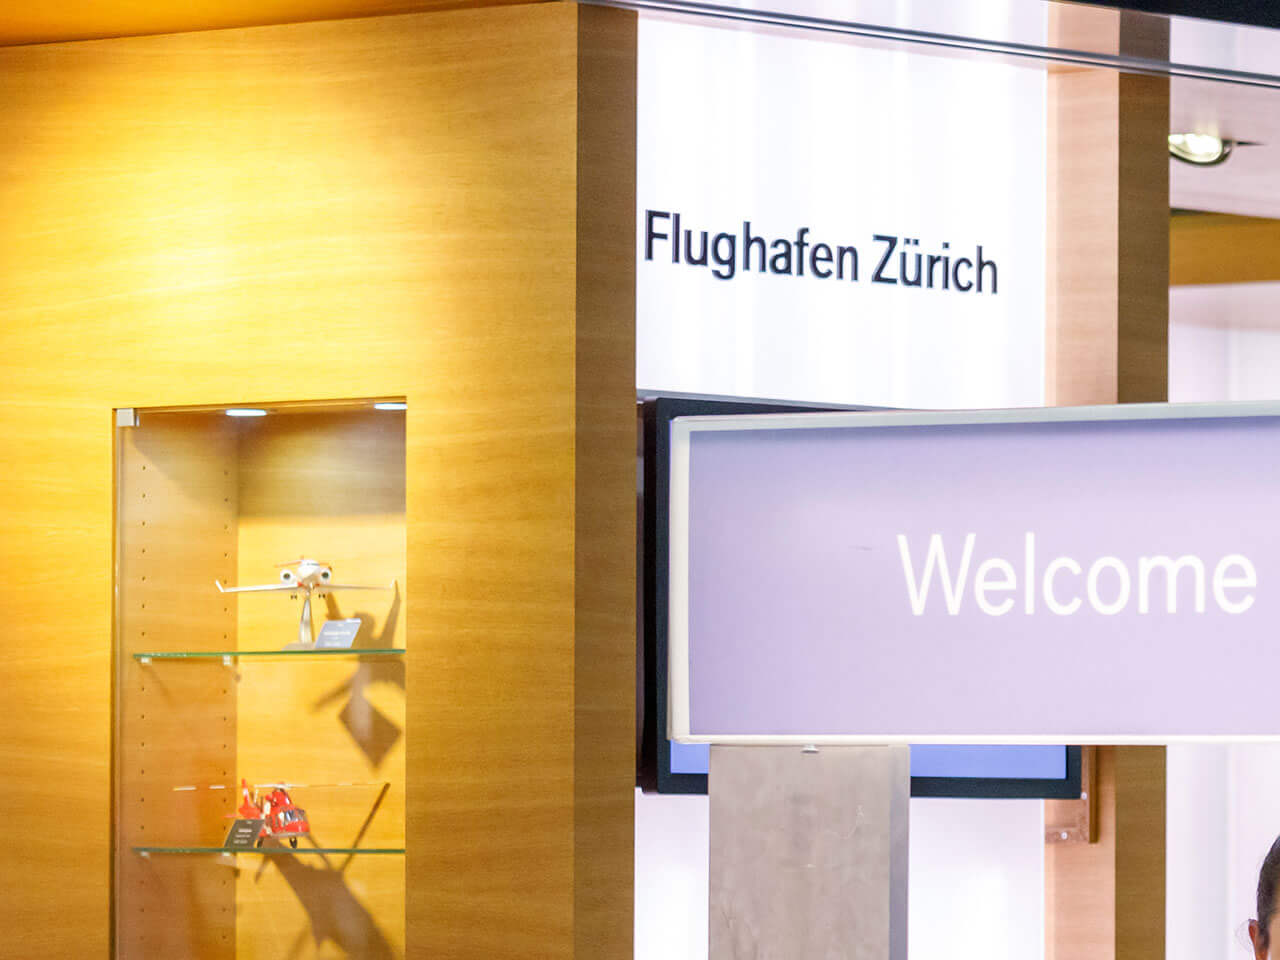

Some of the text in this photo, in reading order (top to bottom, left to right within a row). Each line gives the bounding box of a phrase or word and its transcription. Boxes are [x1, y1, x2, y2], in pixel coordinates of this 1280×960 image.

[645, 209, 998, 294] Flughafen Zürich
[896, 531, 1258, 617] Welcome
